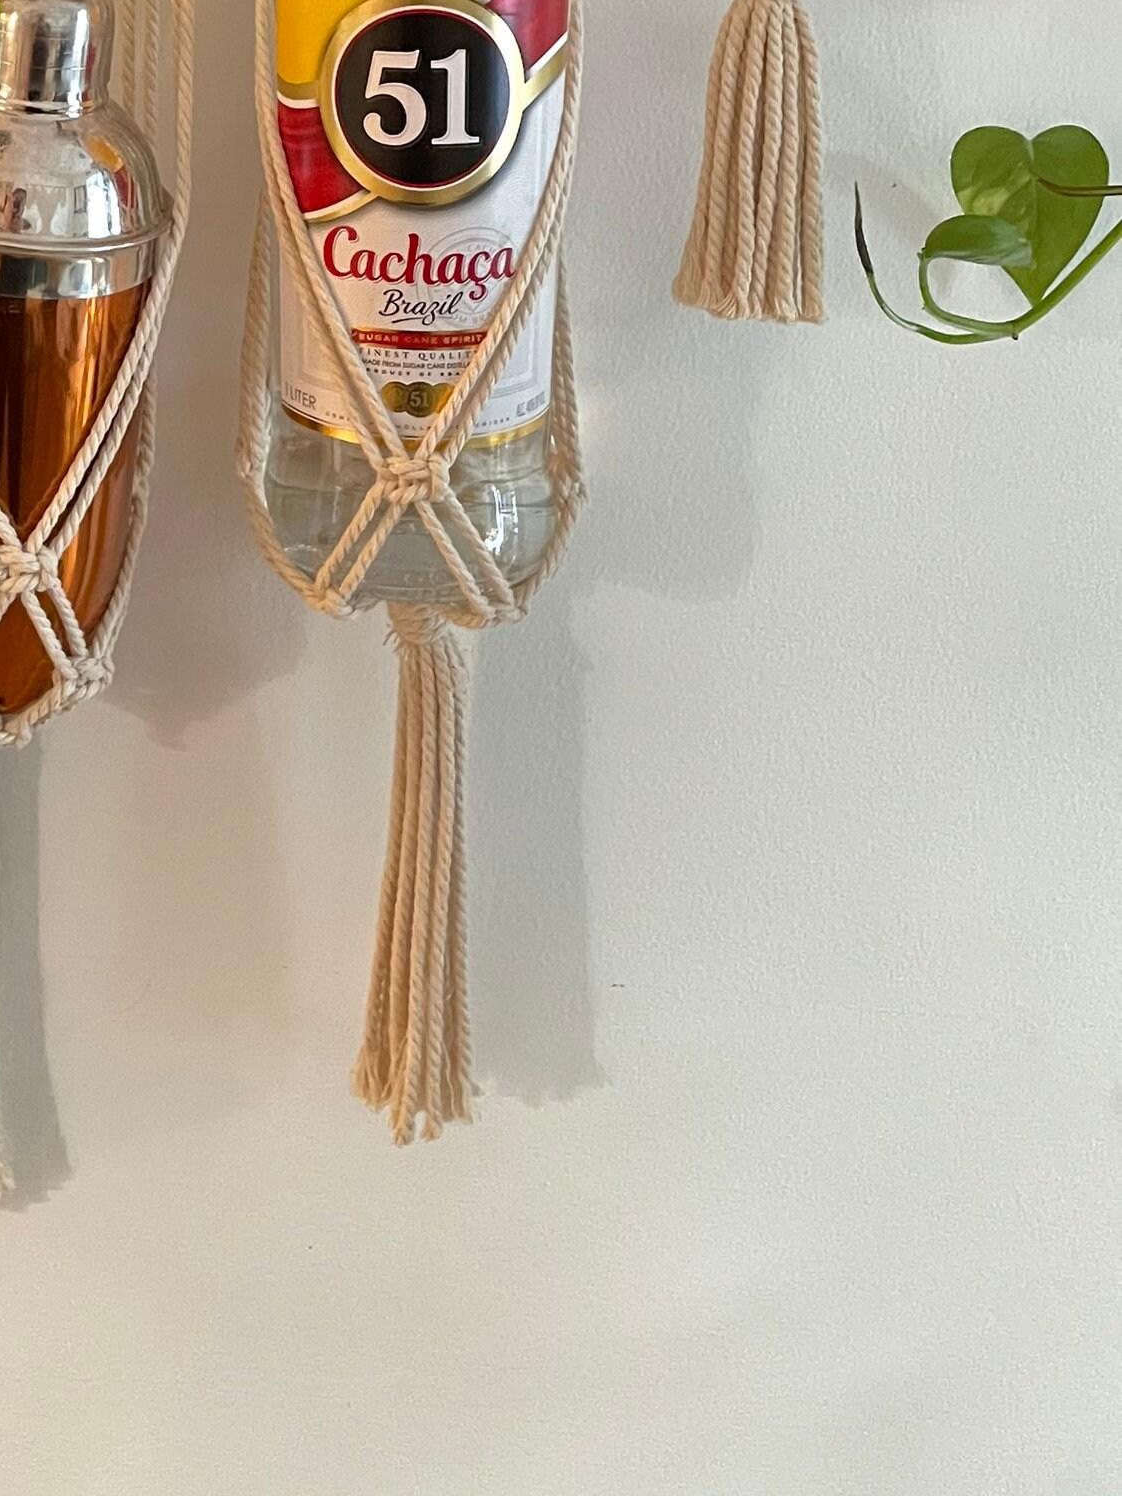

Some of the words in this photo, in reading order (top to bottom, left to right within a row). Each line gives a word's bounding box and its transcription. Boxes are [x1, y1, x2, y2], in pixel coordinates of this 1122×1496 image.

[363, 49, 480, 146] 51
[323, 225, 518, 301] Cachaça
[378, 288, 465, 326] Brazil
[358, 332, 399, 343] SUGAR
[403, 335, 439, 345] CANE
[442, 333, 484, 345] SPIRIT
[290, 385, 318, 411] LITER
[409, 390, 430, 408] 51
